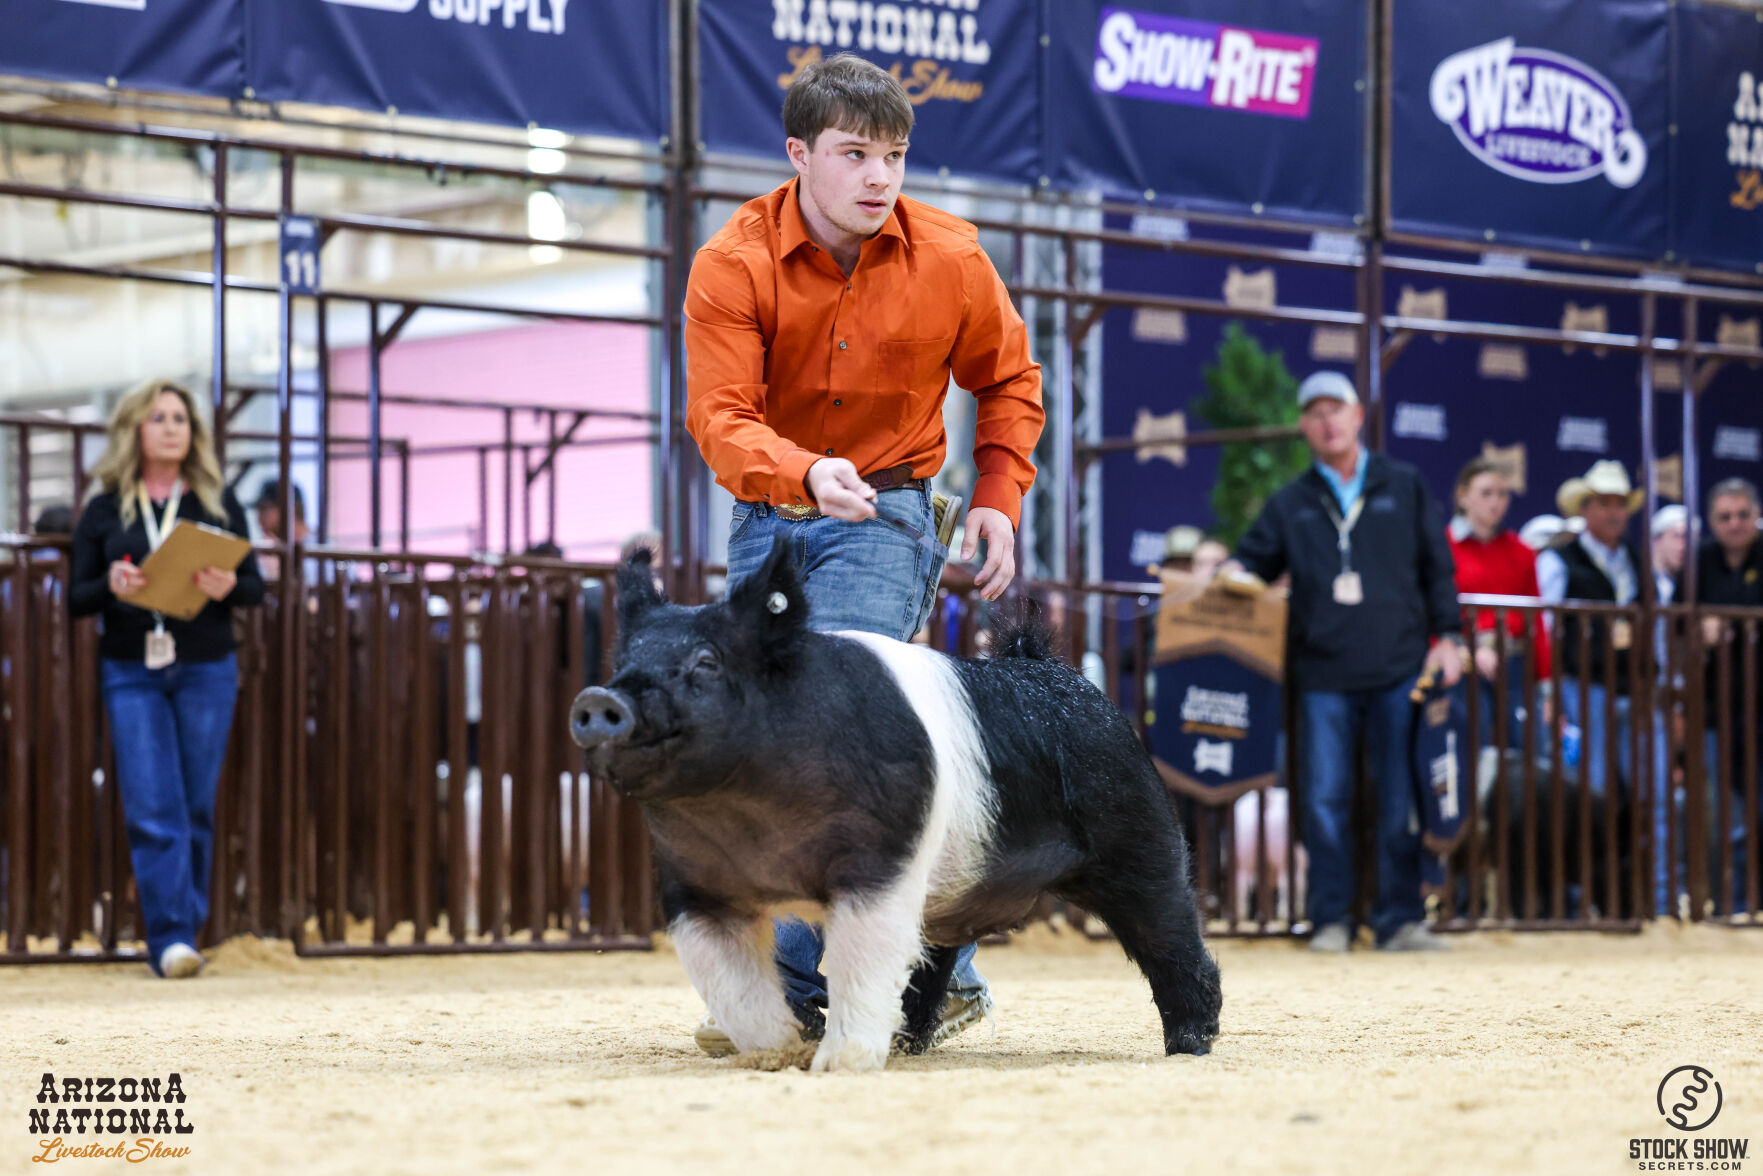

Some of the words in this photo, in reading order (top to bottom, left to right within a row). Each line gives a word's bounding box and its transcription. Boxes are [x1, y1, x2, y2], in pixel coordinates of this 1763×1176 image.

[772, 0, 991, 64] NATIONAL
[1429, 37, 1648, 188] WEAVER
[1485, 131, 1592, 169] LIVESTOCK
[285, 250, 315, 288] 11
